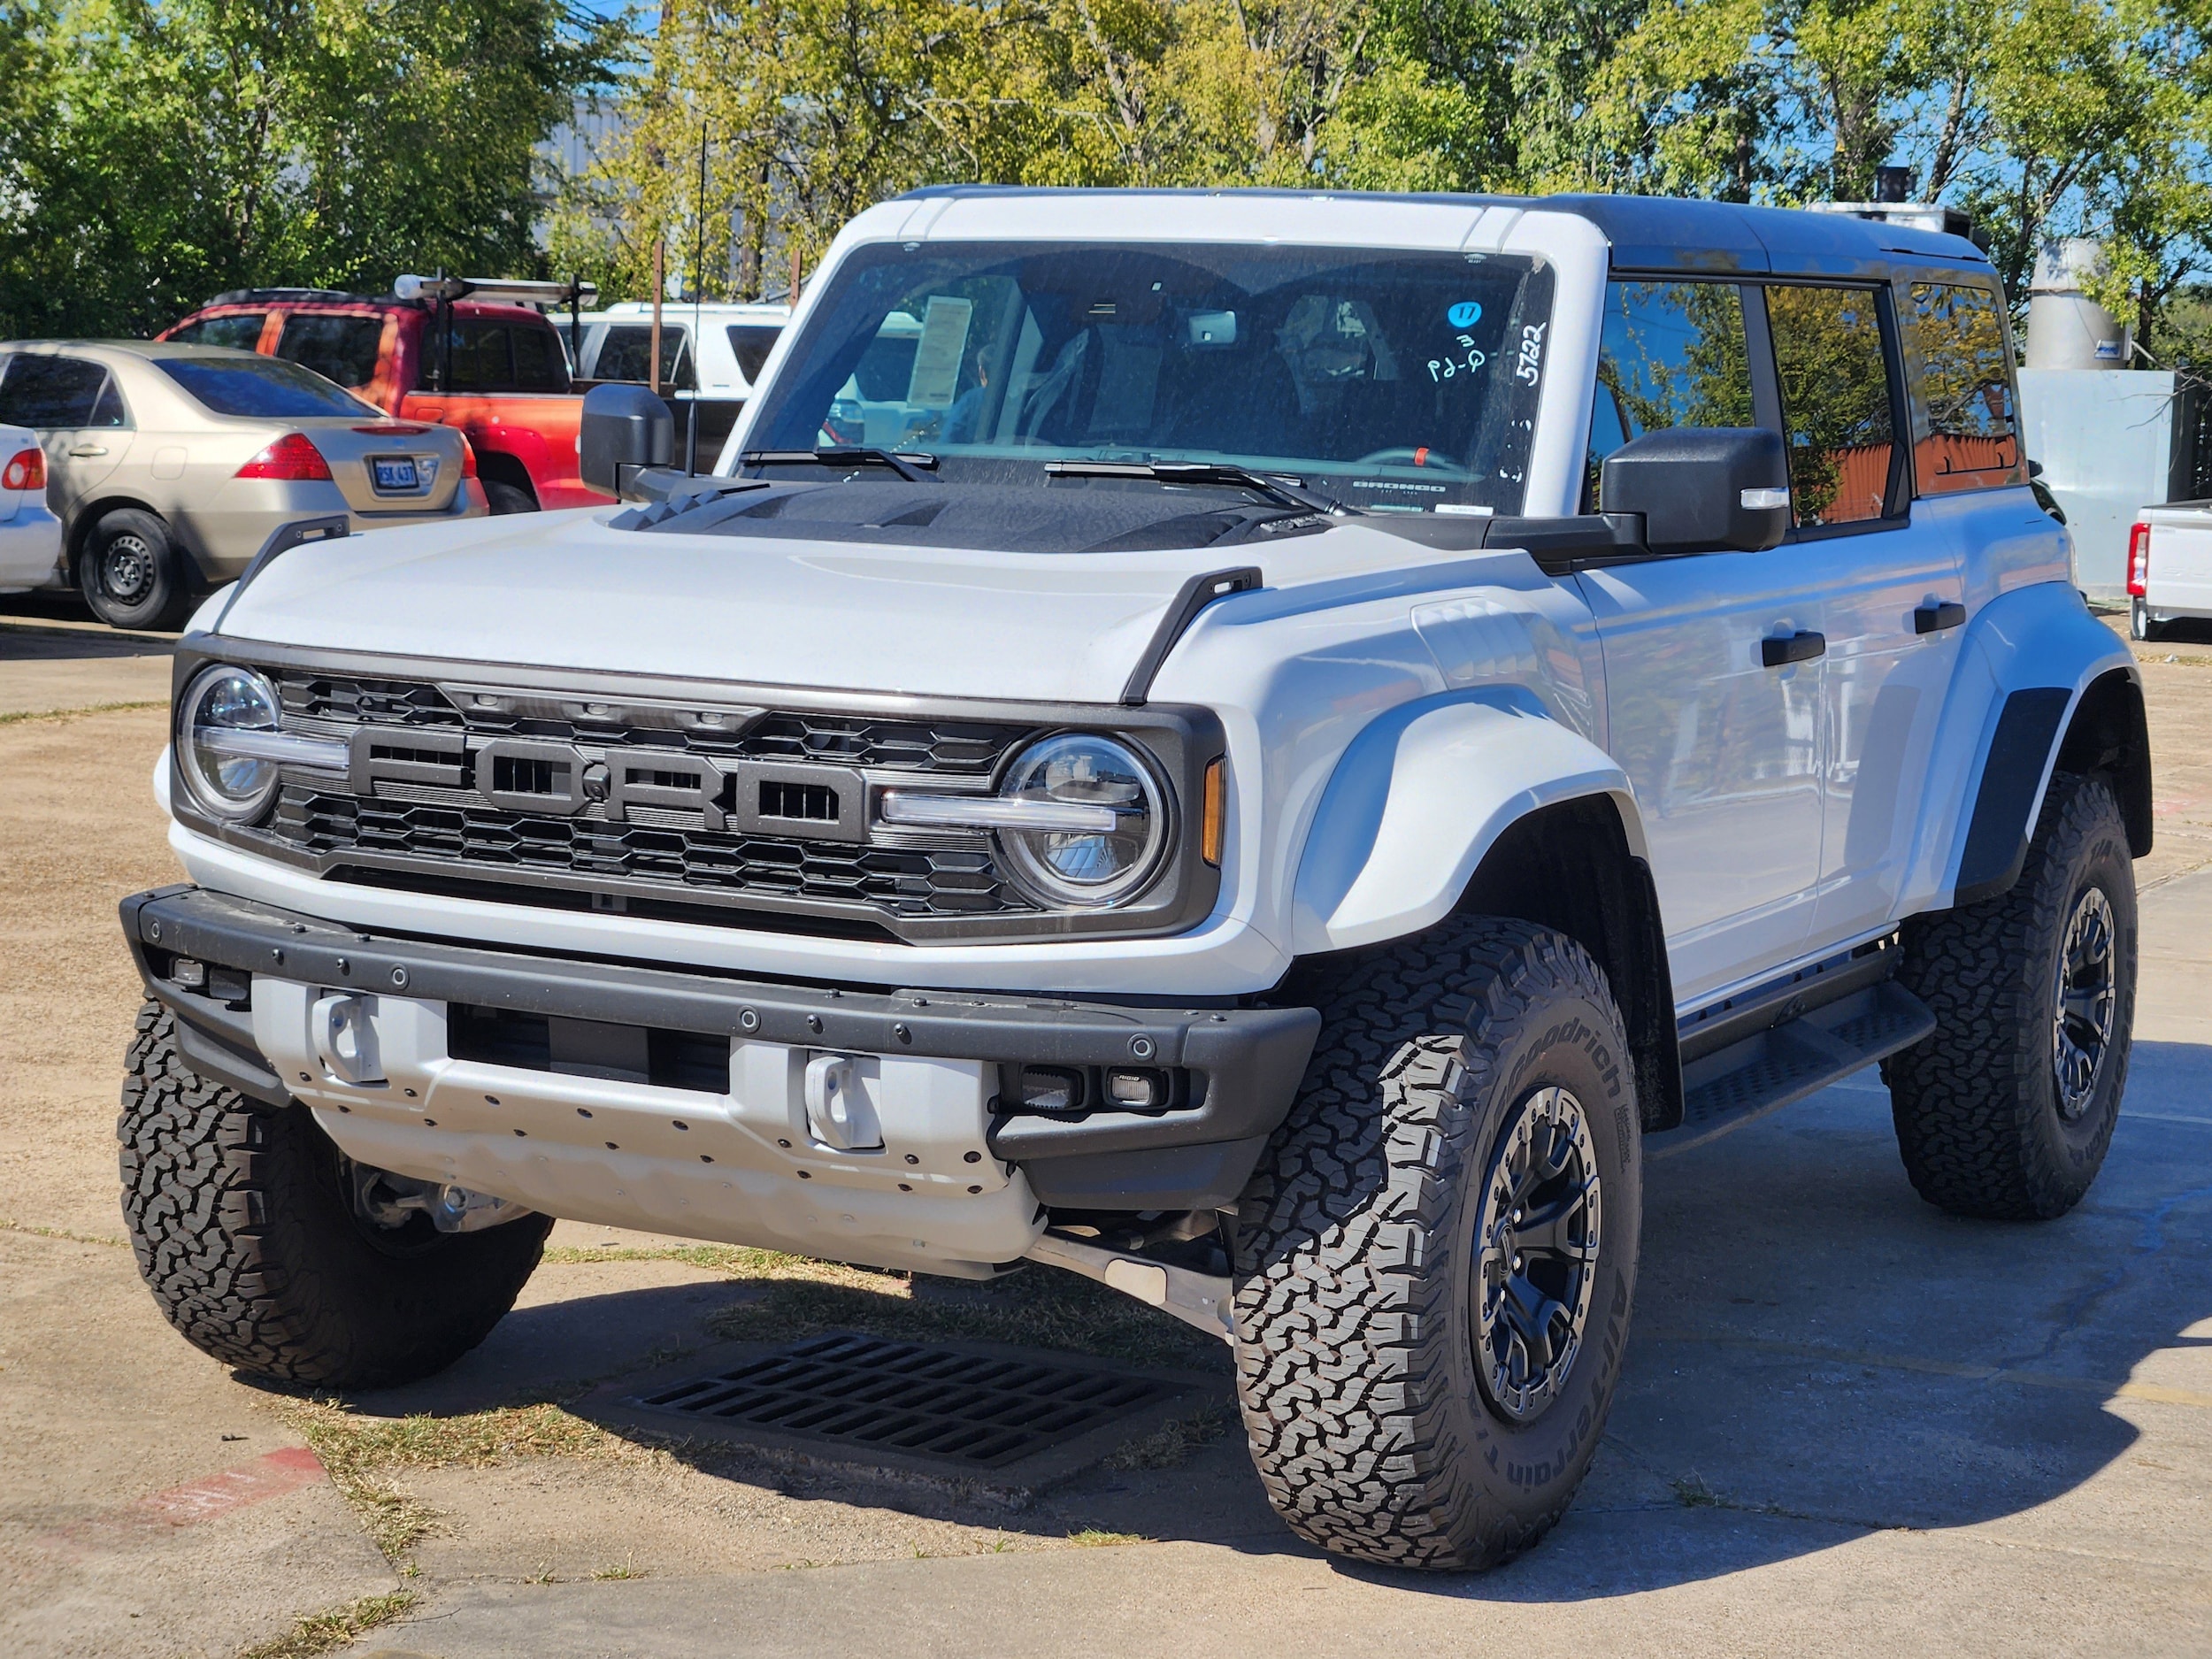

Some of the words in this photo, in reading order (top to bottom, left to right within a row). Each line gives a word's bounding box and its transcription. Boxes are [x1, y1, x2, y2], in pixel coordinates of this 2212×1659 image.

[1458, 305, 1477, 319] 17
[1516, 321, 1547, 387] 5722
[1352, 480, 1447, 493] BRONCO
[349, 725, 872, 844] FORD
